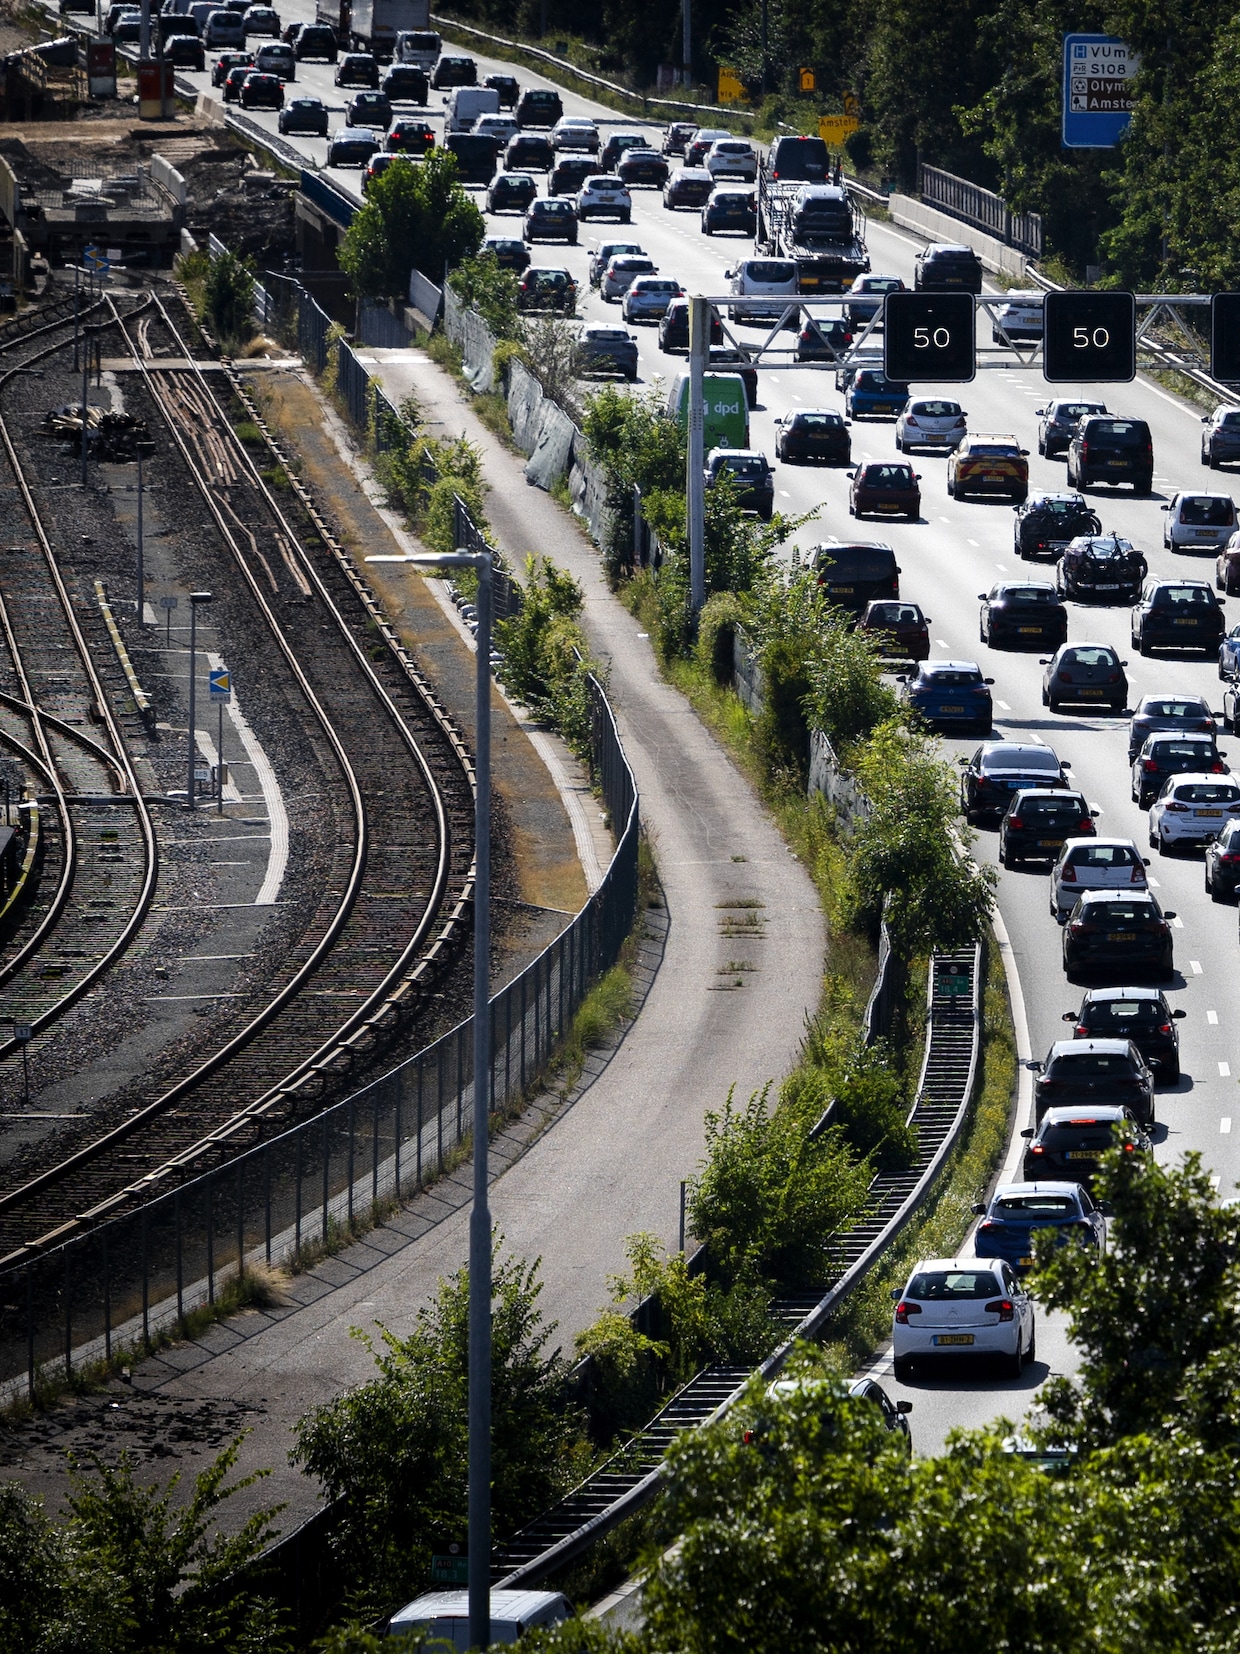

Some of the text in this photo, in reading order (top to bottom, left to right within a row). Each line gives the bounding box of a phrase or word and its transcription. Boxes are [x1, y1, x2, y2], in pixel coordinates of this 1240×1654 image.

[1090, 63, 1126, 75] S108
[1090, 80, 1130, 94] Olym
[913, 327, 951, 348] 50
[1073, 327, 1110, 348] 50
[714, 401, 739, 416] dpd
[436, 1560, 453, 1569] A10
